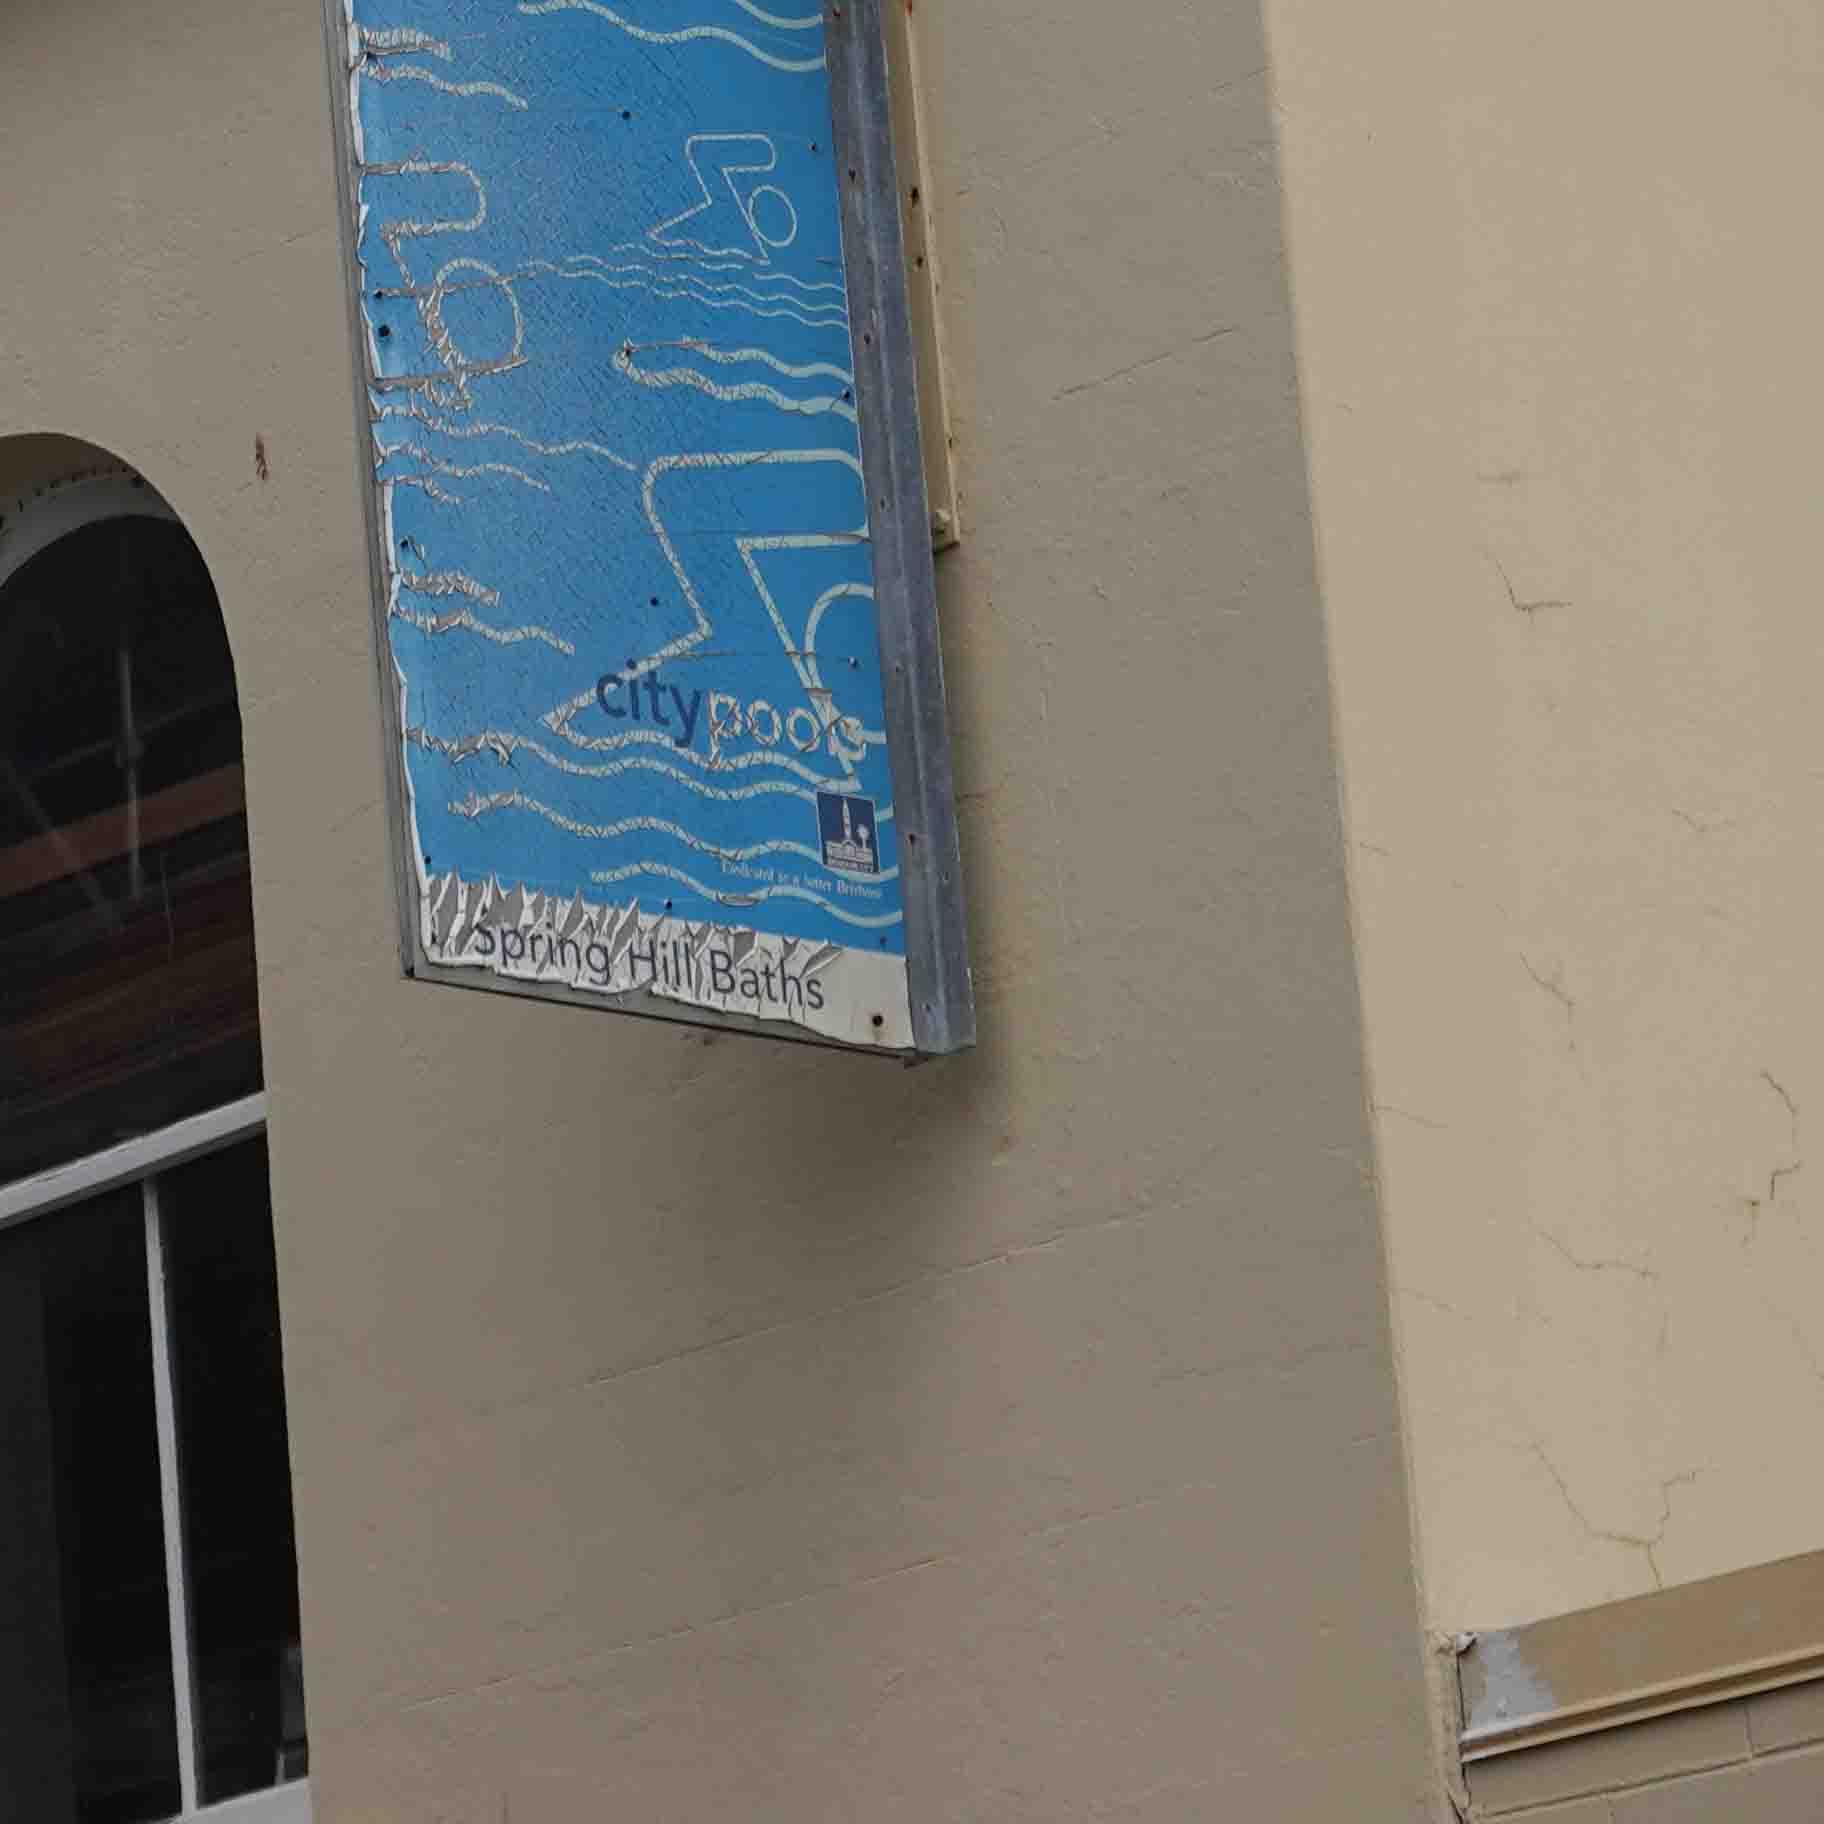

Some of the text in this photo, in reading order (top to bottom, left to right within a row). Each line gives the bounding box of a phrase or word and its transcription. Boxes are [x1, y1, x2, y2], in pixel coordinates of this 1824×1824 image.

[474, 906, 825, 1011] Spring Hill Baths
